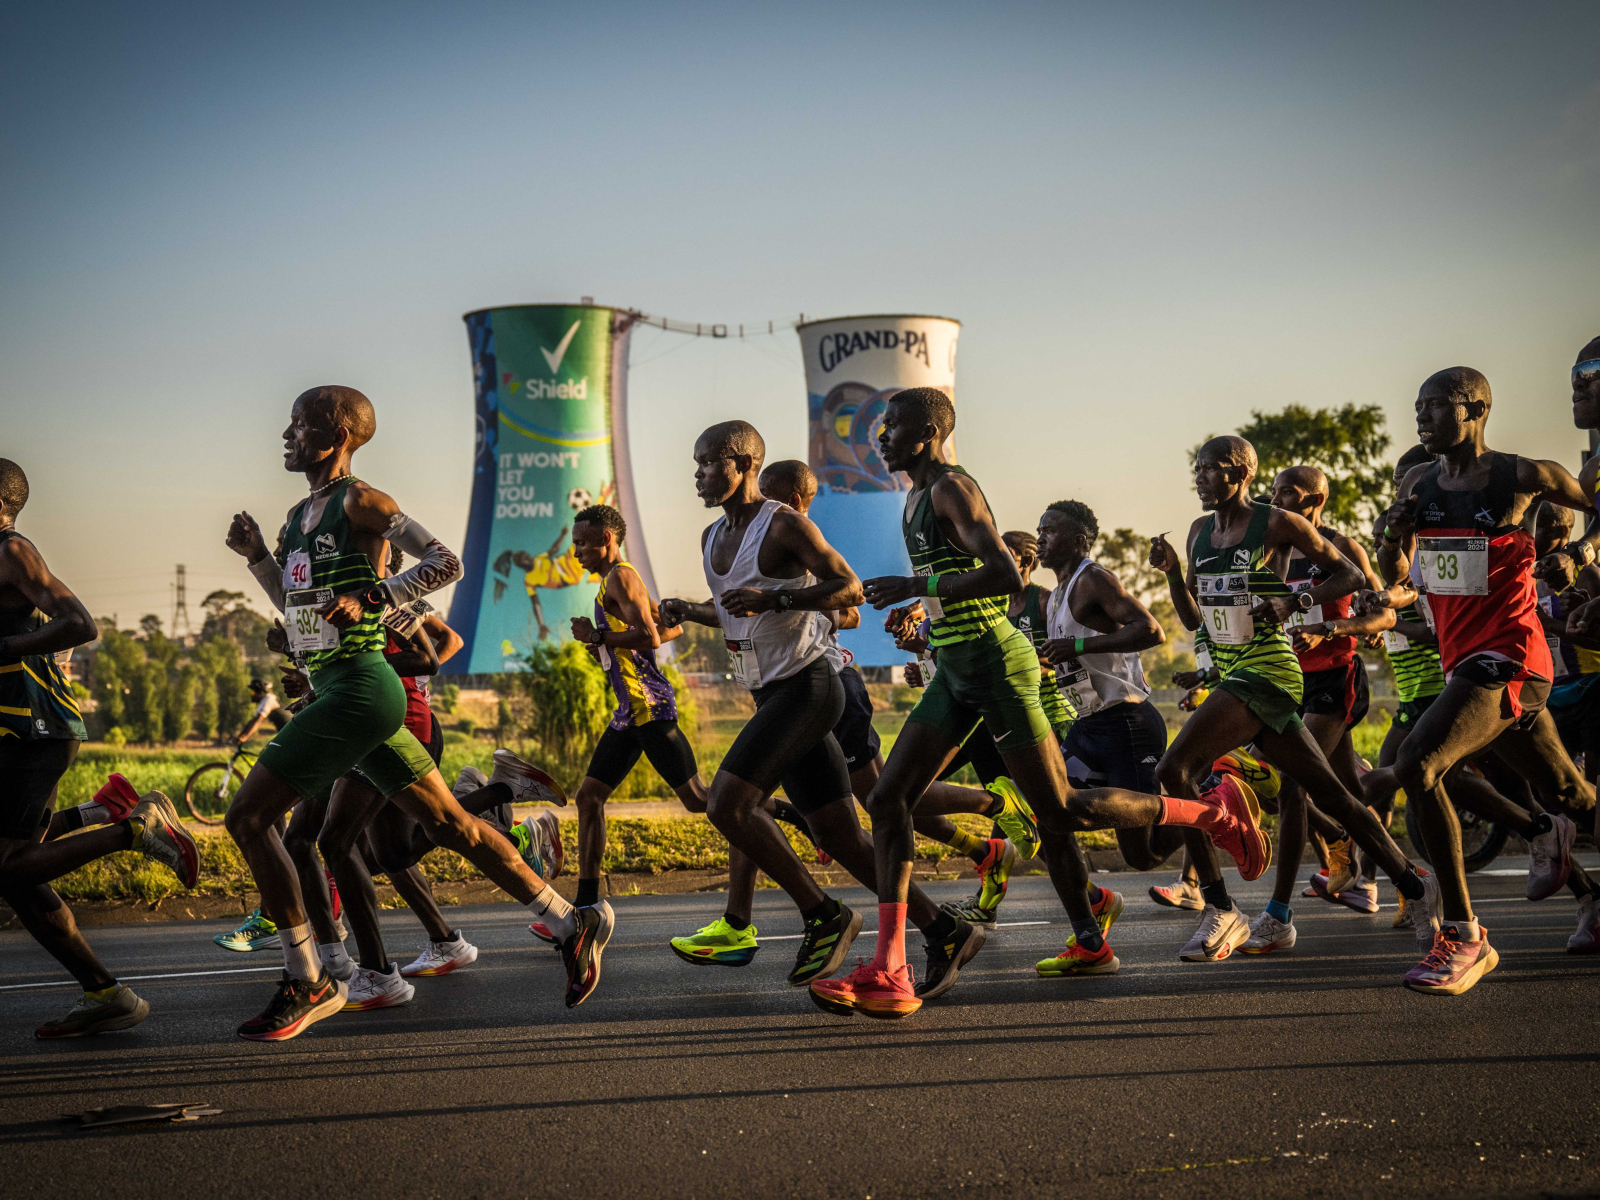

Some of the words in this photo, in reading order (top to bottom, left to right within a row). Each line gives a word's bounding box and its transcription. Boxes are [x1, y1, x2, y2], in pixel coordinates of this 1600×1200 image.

[819, 330, 930, 373] GRAND-PA
[525, 378, 587, 399] Shield
[500, 453, 513, 468] IT
[517, 452, 581, 468] WON'T
[499, 470, 524, 485] LET
[498, 486, 534, 501] YOU
[496, 503, 553, 518] DOWN
[315, 551, 340, 560] NEDBANK
[1421, 556, 1426, 566] A
[291, 563, 307, 583] 40
[1437, 553, 1458, 580] 93
[1229, 578, 1244, 586] ASA
[296, 607, 320, 635] 592
[1213, 608, 1228, 631] 61
[1065, 686, 1083, 708] 56
